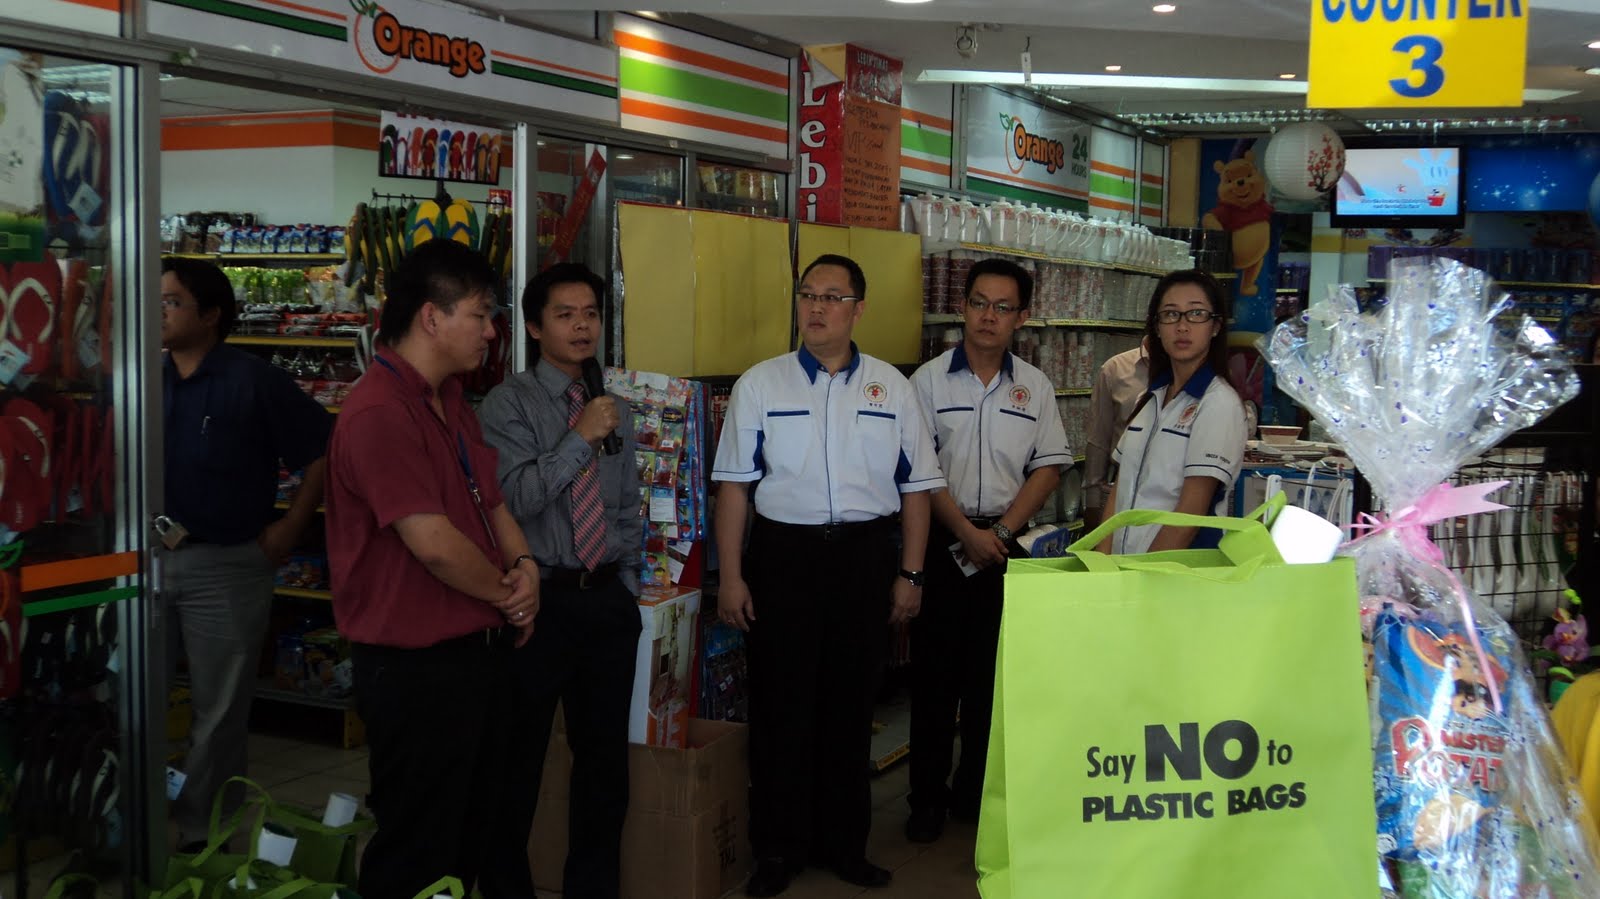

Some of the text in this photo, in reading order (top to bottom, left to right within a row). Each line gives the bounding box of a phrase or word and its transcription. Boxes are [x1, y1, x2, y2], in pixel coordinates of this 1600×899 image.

[373, 12, 486, 78] Orange
[1389, 35, 1445, 98] 3
[1013, 122, 1064, 174] Orange
[1071, 133, 1088, 162] 24
[1071, 162, 1087, 178] HOURS
[1087, 720, 1293, 784] Say NO to
[1082, 782, 1307, 823] PLASTIC BAGS
